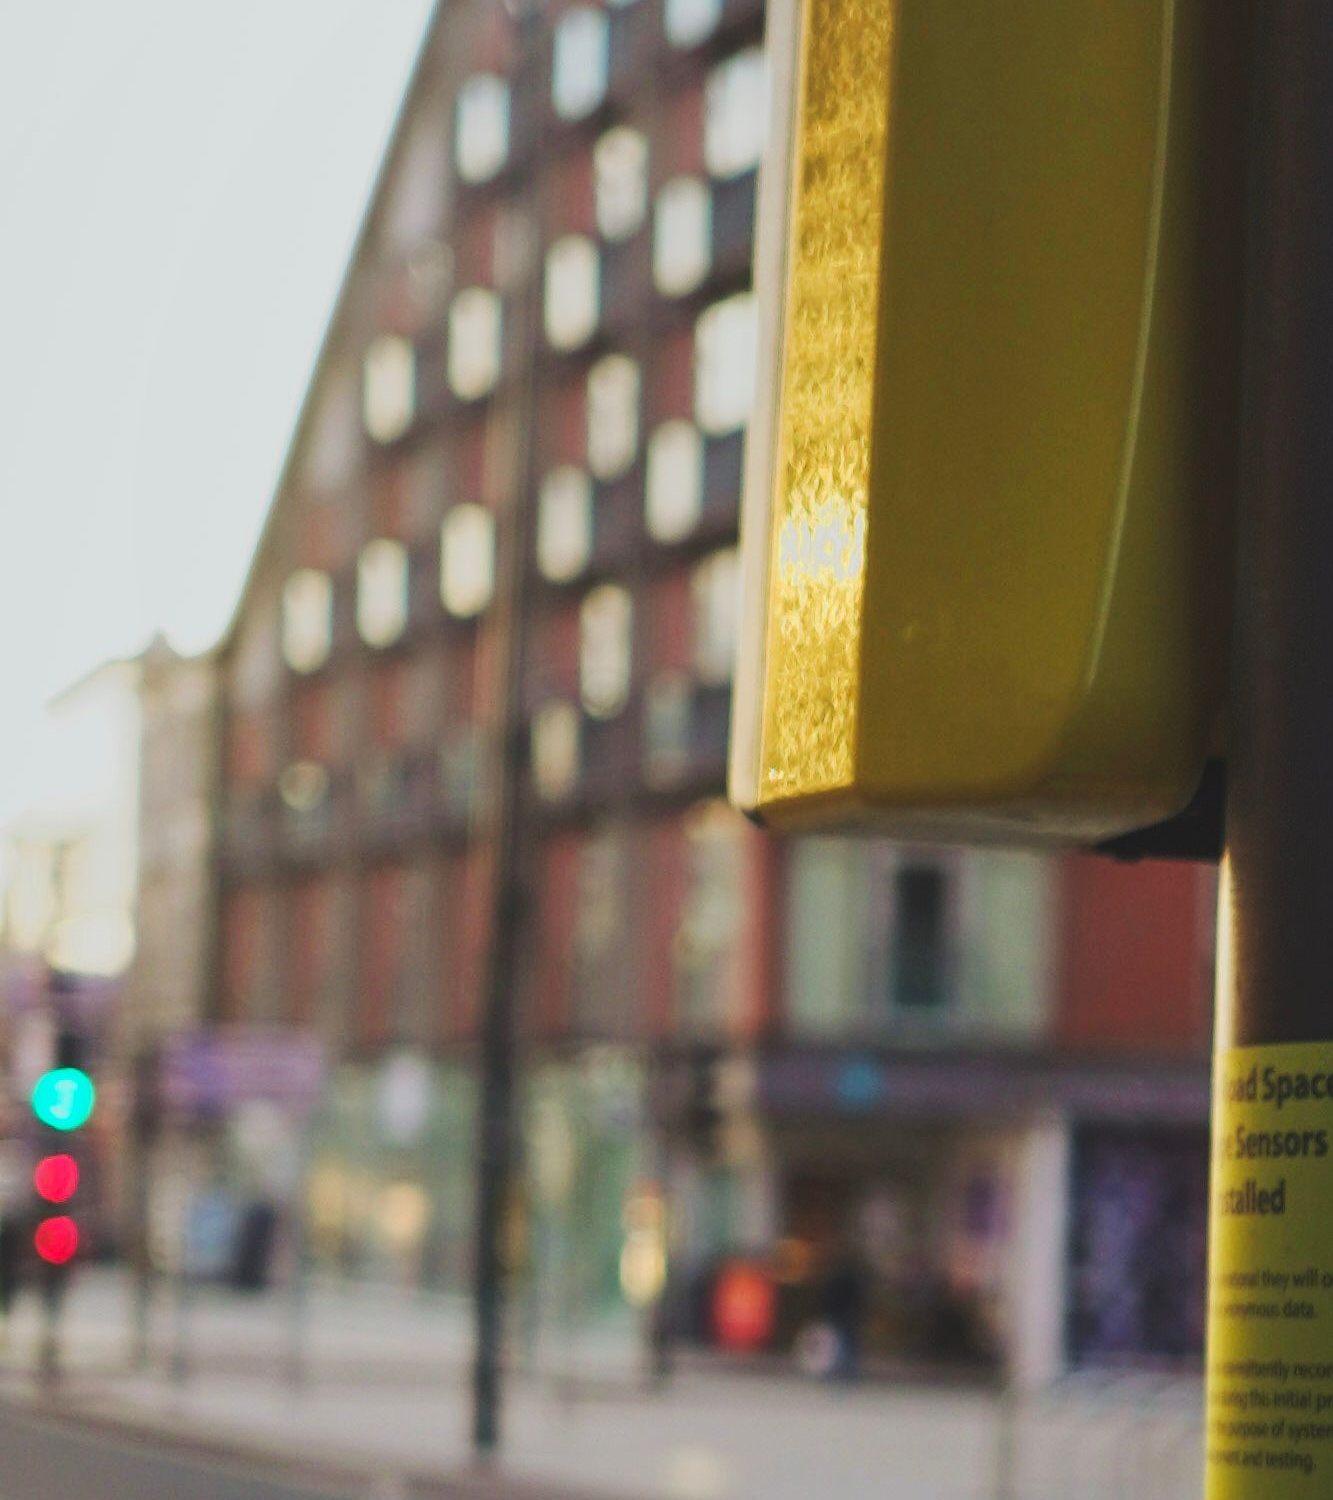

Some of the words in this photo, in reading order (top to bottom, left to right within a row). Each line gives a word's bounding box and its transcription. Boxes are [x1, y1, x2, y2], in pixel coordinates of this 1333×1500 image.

[1236, 1127, 1329, 1158] Sensors
[1261, 1269, 1289, 1293] they
[1292, 1268, 1318, 1289] will
[1274, 1390, 1311, 1409] initial
[1272, 1419, 1286, 1437] of
